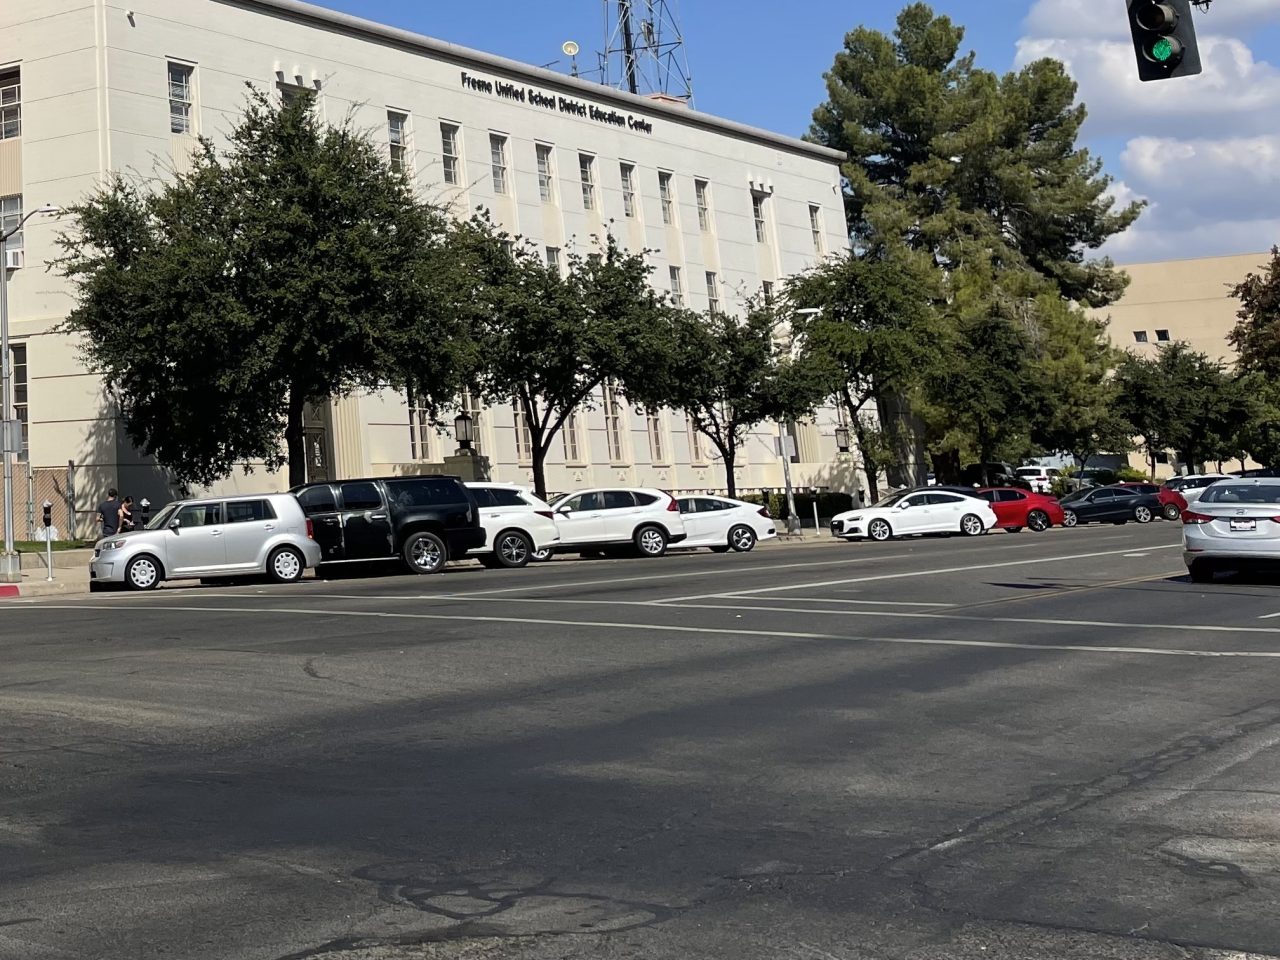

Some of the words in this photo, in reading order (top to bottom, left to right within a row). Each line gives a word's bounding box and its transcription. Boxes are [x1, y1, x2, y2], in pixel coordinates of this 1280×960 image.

[461, 71, 492, 94] Fresno
[495, 80, 525, 103] Unified
[528, 88, 556, 110] School
[558, 96, 587, 118] District
[588, 104, 626, 128] Education
[628, 114, 652, 135] Center
